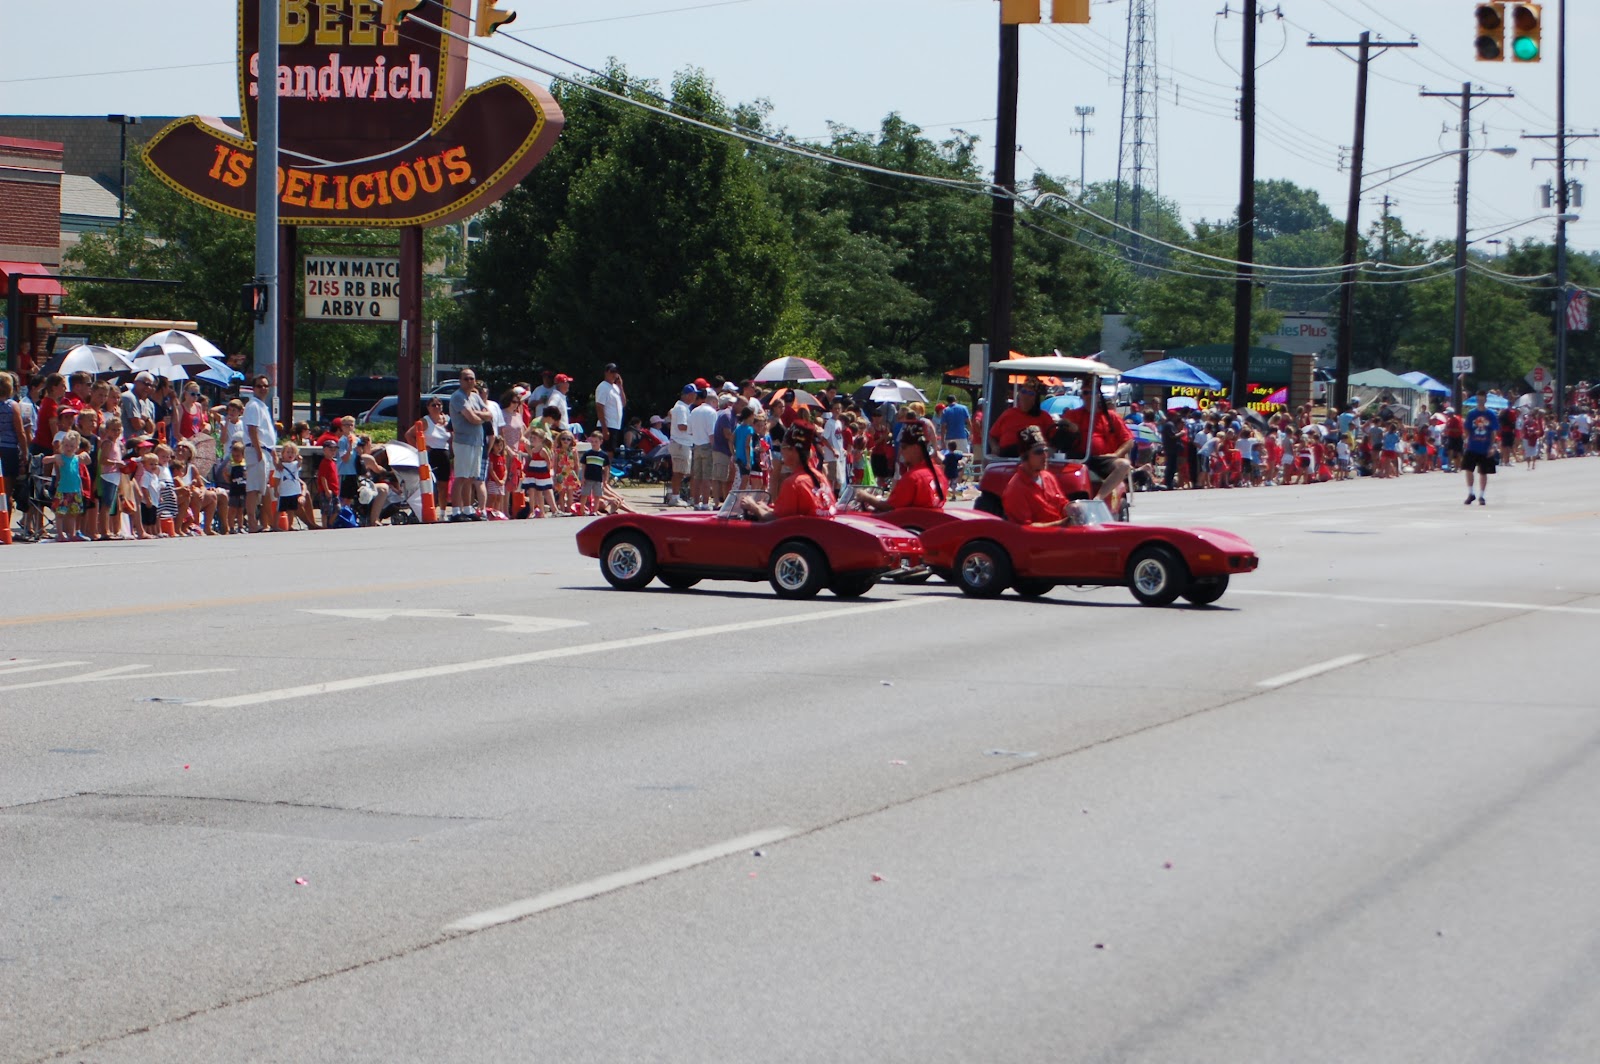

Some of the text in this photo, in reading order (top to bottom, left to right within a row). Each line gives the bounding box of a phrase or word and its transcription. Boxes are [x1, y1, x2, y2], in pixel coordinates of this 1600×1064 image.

[278, 0, 399, 46] BEE
[208, 145, 254, 188] IS
[306, 261, 336, 276] MIX
[344, 281, 366, 297] RB
[321, 300, 381, 317] ARBY Q
[1455, 359, 1471, 371] 49
[1252, 387, 1268, 396] July
